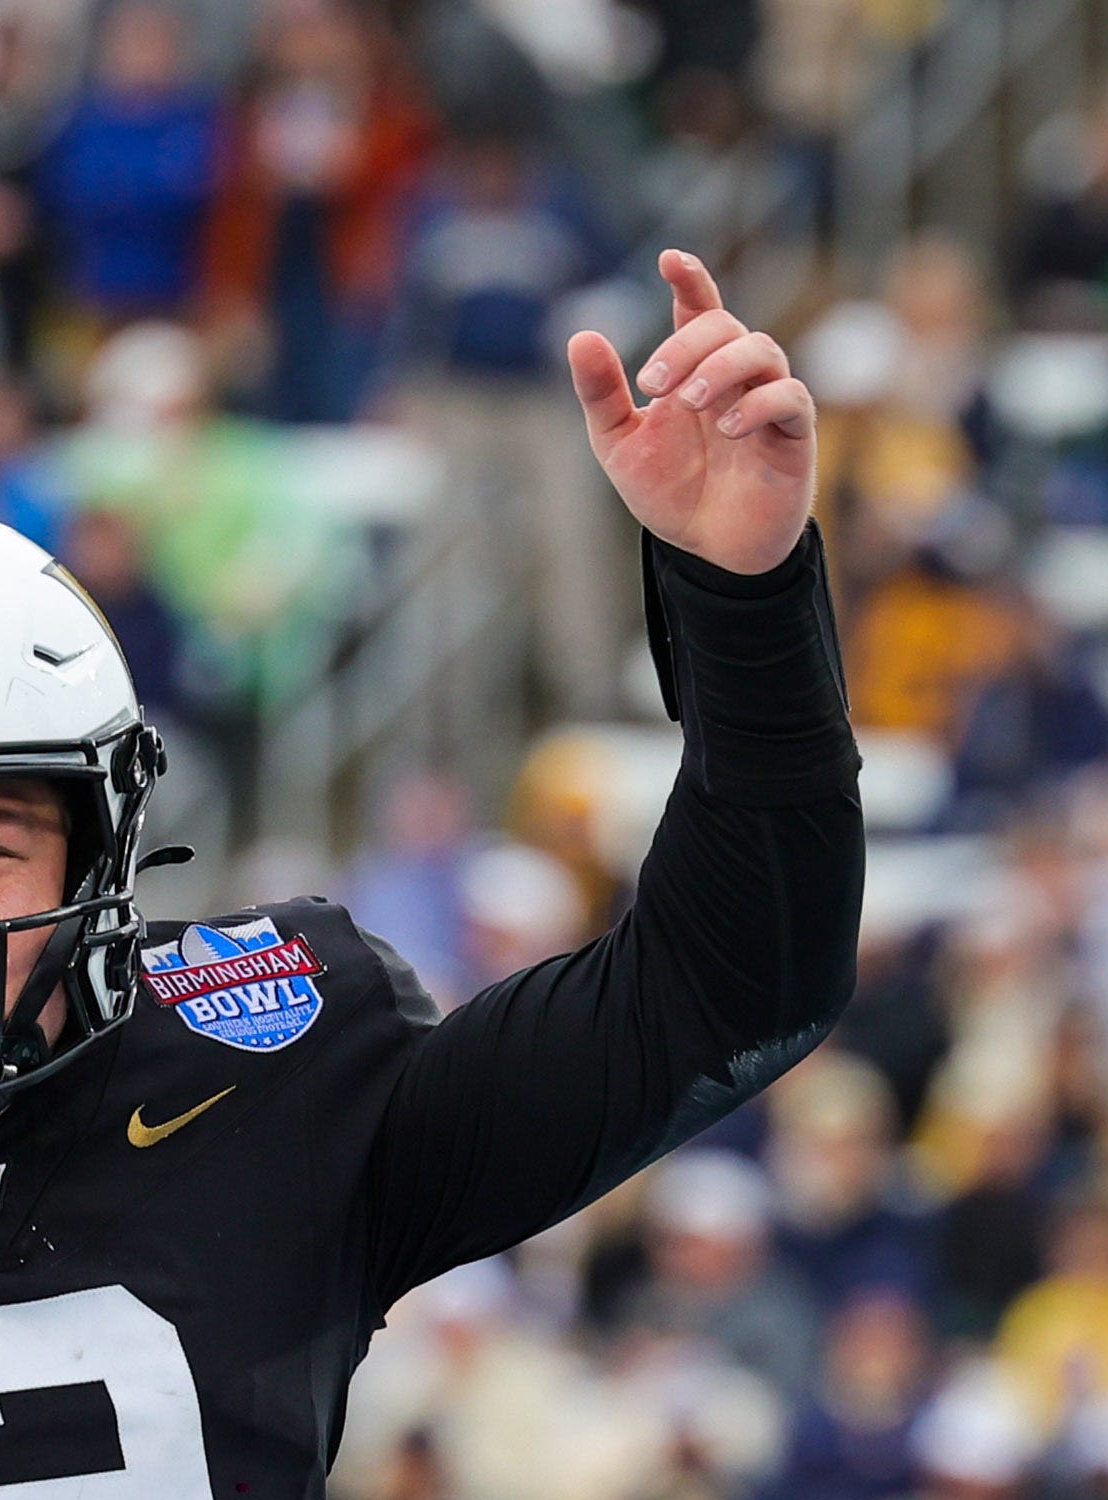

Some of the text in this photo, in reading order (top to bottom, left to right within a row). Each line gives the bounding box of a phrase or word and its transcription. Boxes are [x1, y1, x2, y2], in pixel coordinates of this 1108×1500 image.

[147, 943, 314, 1000] BIRMINGHAM
[187, 977, 310, 1023] BOWL
[251, 1004, 315, 1025] HOSPITALITY
